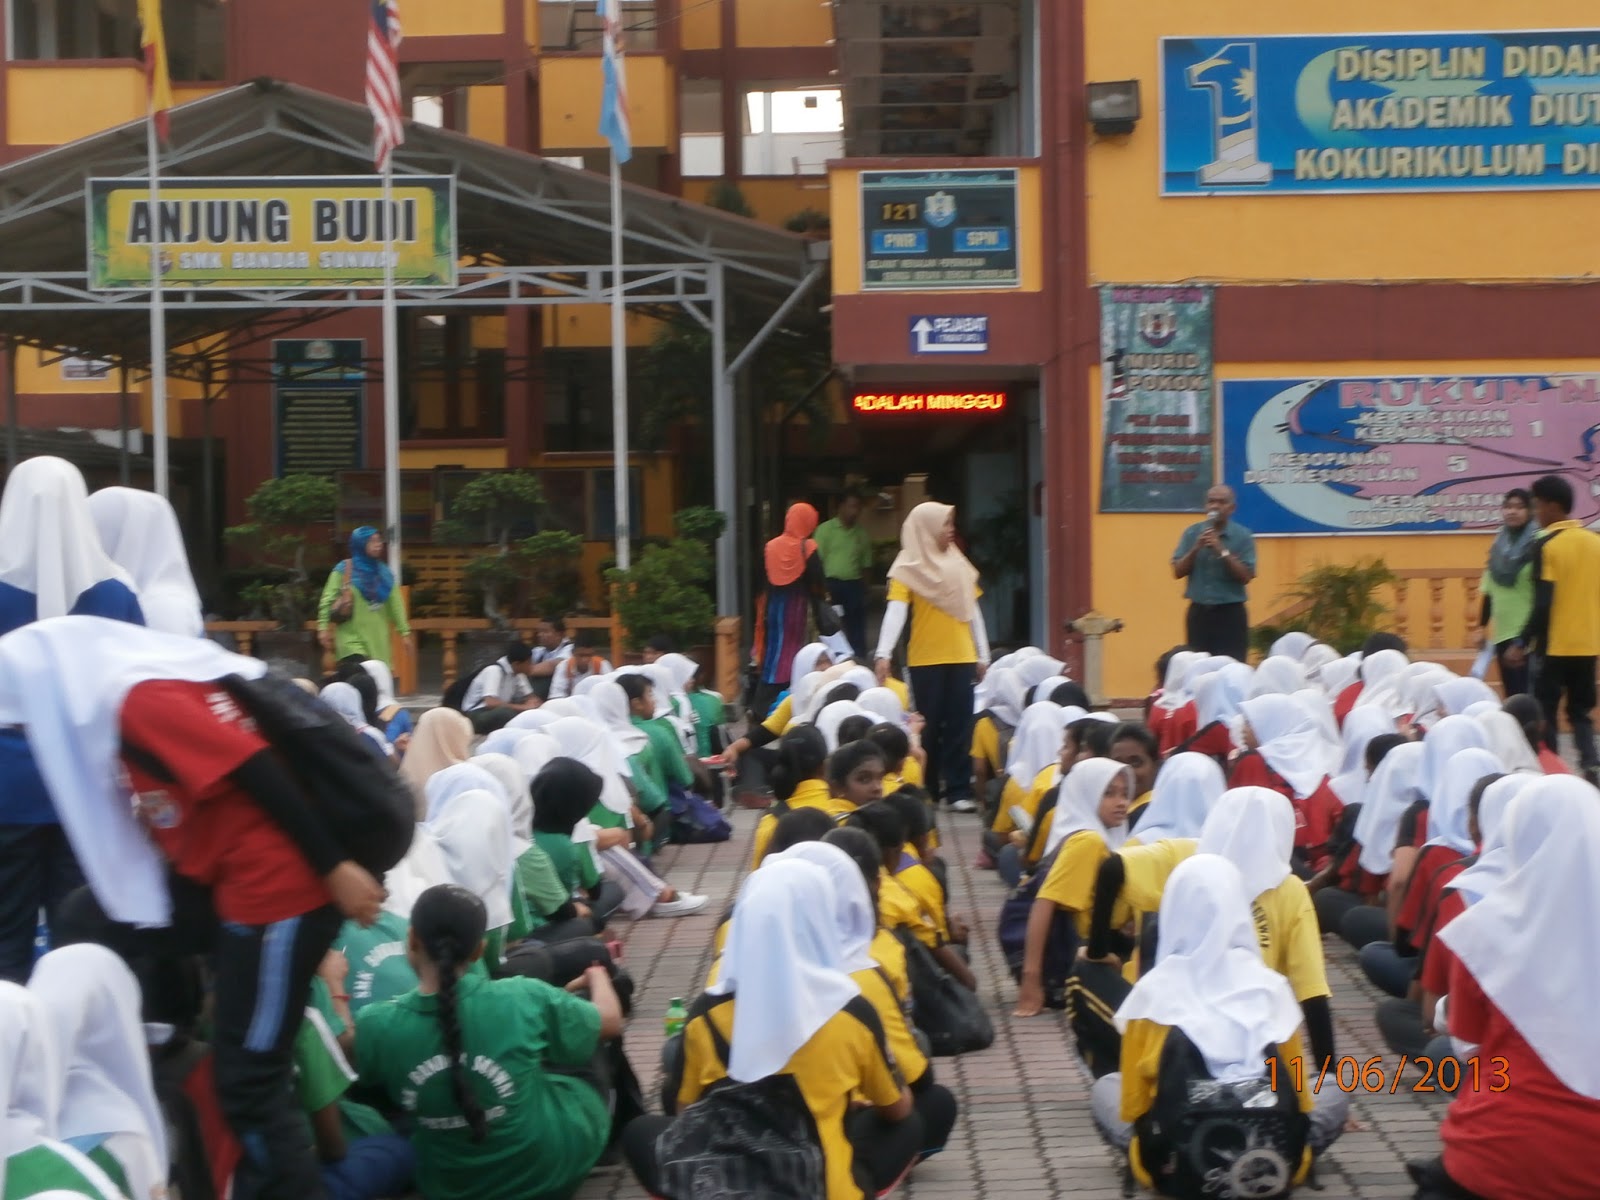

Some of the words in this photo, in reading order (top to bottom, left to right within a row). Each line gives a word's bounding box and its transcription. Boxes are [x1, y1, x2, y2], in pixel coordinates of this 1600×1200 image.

[1336, 46, 1486, 82] DISIPLIN
[1332, 95, 1513, 130] AKADEMIK
[1295, 144, 1545, 181] KOKURIKULUM
[882, 203, 918, 220] 121
[128, 199, 290, 243] ANJUNG
[314, 198, 416, 242] BUDI
[179, 251, 223, 269] SMK
[926, 394, 1005, 410] MINGGU
[1359, 410, 1510, 424] KEPERCAYAAN
[1529, 420, 1543, 437] 1
[1447, 455, 1469, 472] 5
